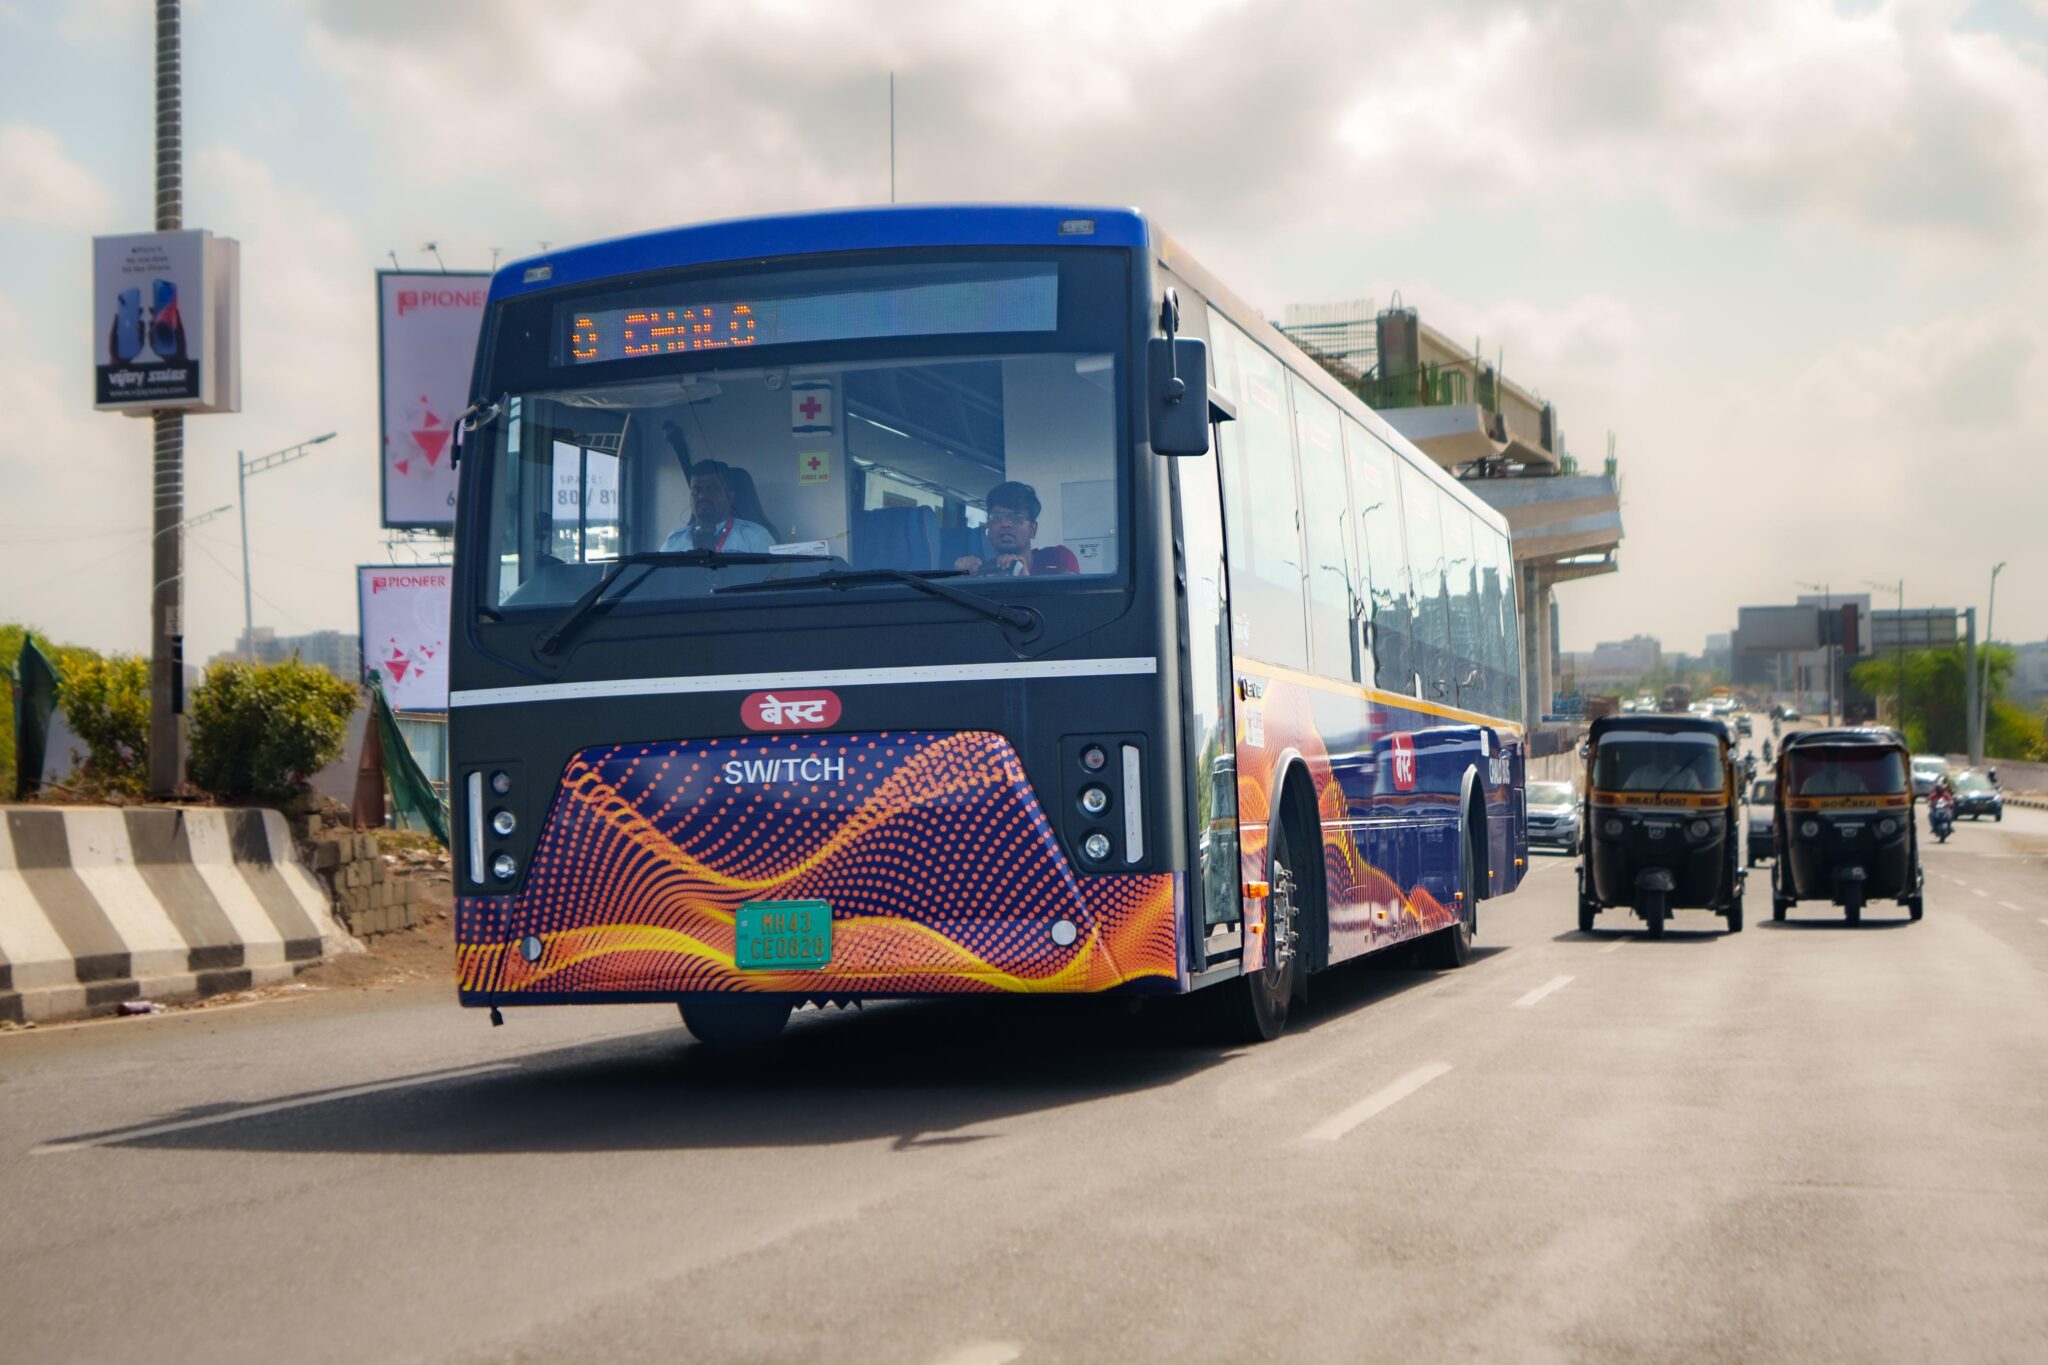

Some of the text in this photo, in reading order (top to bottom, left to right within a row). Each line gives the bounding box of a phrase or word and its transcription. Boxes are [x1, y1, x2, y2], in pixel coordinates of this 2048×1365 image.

[422, 289, 487, 306] PIONE
[624, 305, 755, 354] CHALO
[389, 576, 446, 588] PIONEER
[759, 694, 827, 726] बेस्ट
[724, 757, 845, 785] SWITCH
